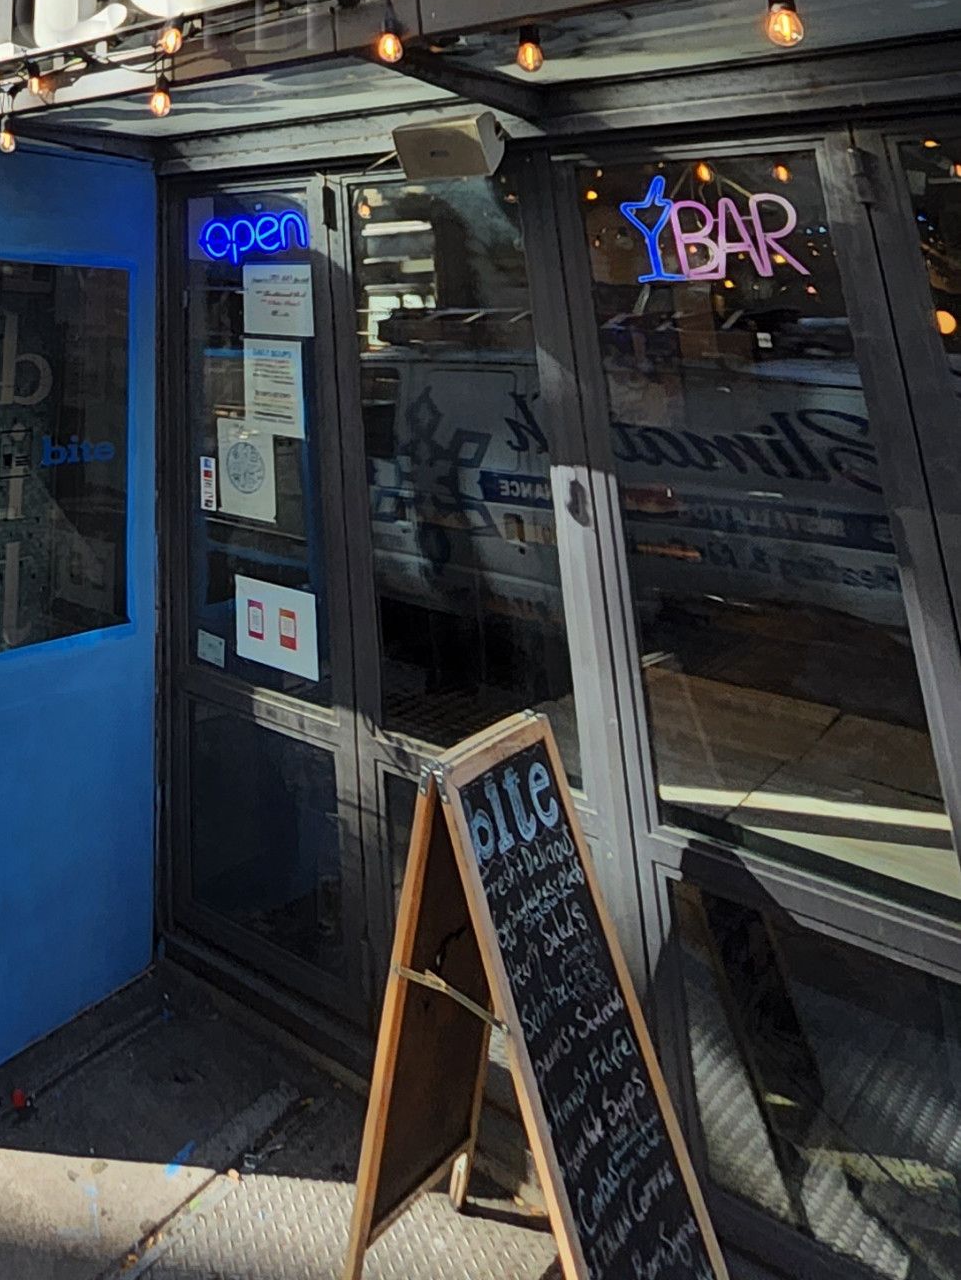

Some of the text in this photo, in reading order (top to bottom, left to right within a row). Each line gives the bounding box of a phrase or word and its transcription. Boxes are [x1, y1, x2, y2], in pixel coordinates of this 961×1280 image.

[204, 208, 308, 264] open
[670, 192, 811, 280] BAR
[41, 434, 116, 467] bite
[466, 761, 560, 866] bite
[600, 1065, 647, 1128] Soups
